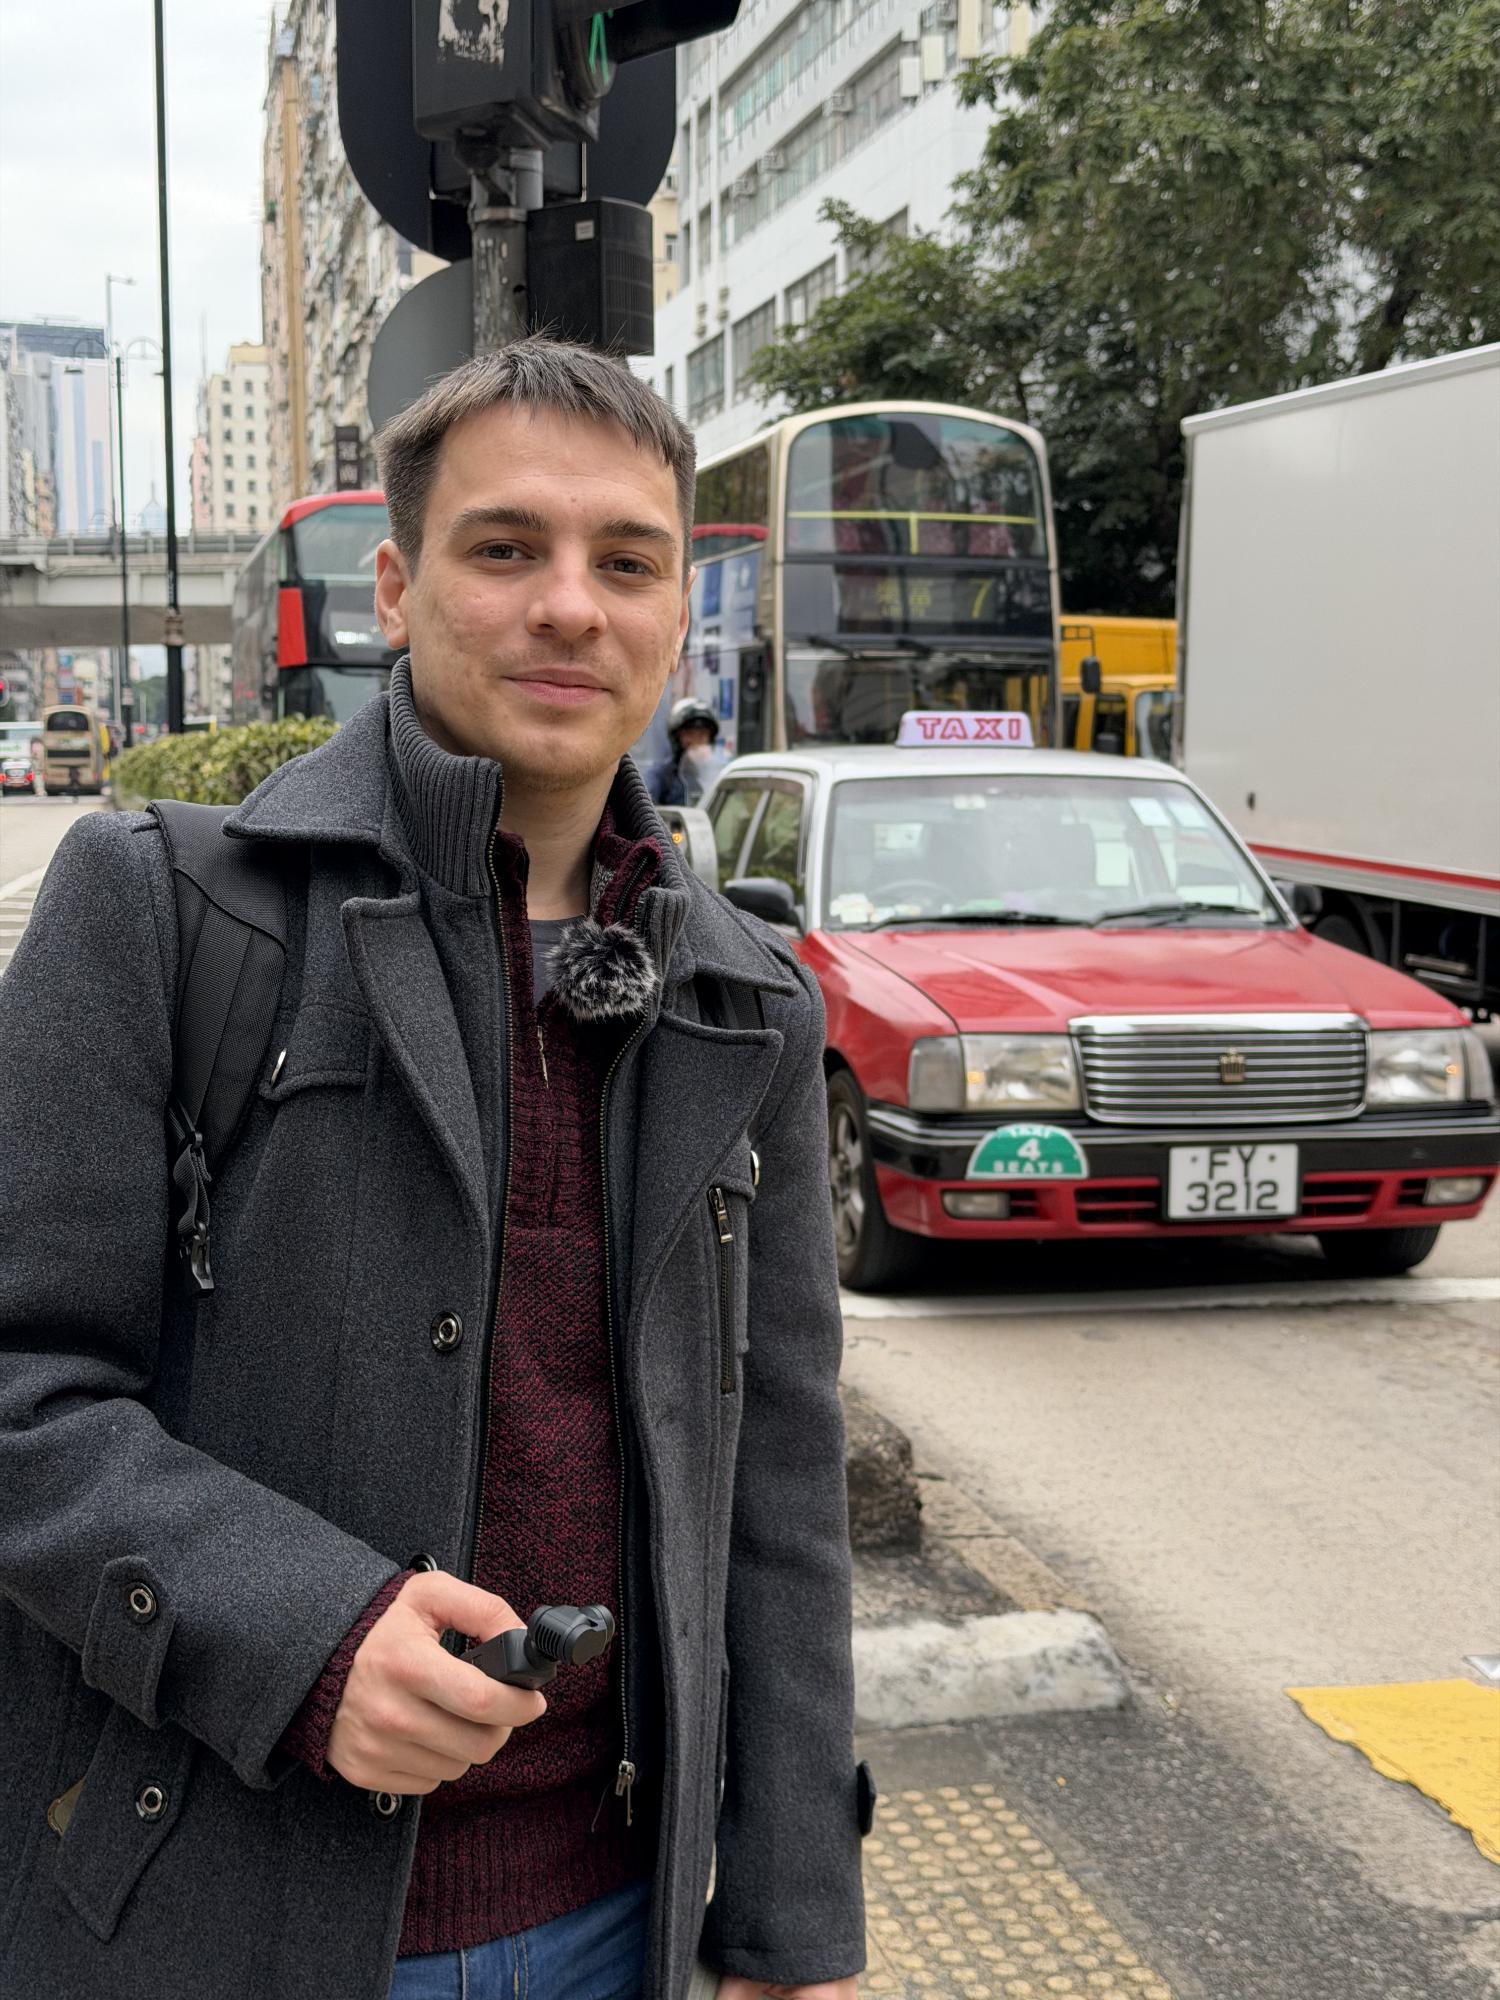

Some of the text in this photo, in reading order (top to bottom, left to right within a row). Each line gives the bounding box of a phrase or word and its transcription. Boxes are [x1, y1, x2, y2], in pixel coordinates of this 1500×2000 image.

[969, 578, 993, 619] 7
[916, 717, 1021, 740] TAXI
[1017, 1139, 1041, 1160] 4
[1208, 1145, 1257, 1180] FY
[993, 1160, 1063, 1173] SEATS
[1186, 1180, 1279, 1212] 3212
